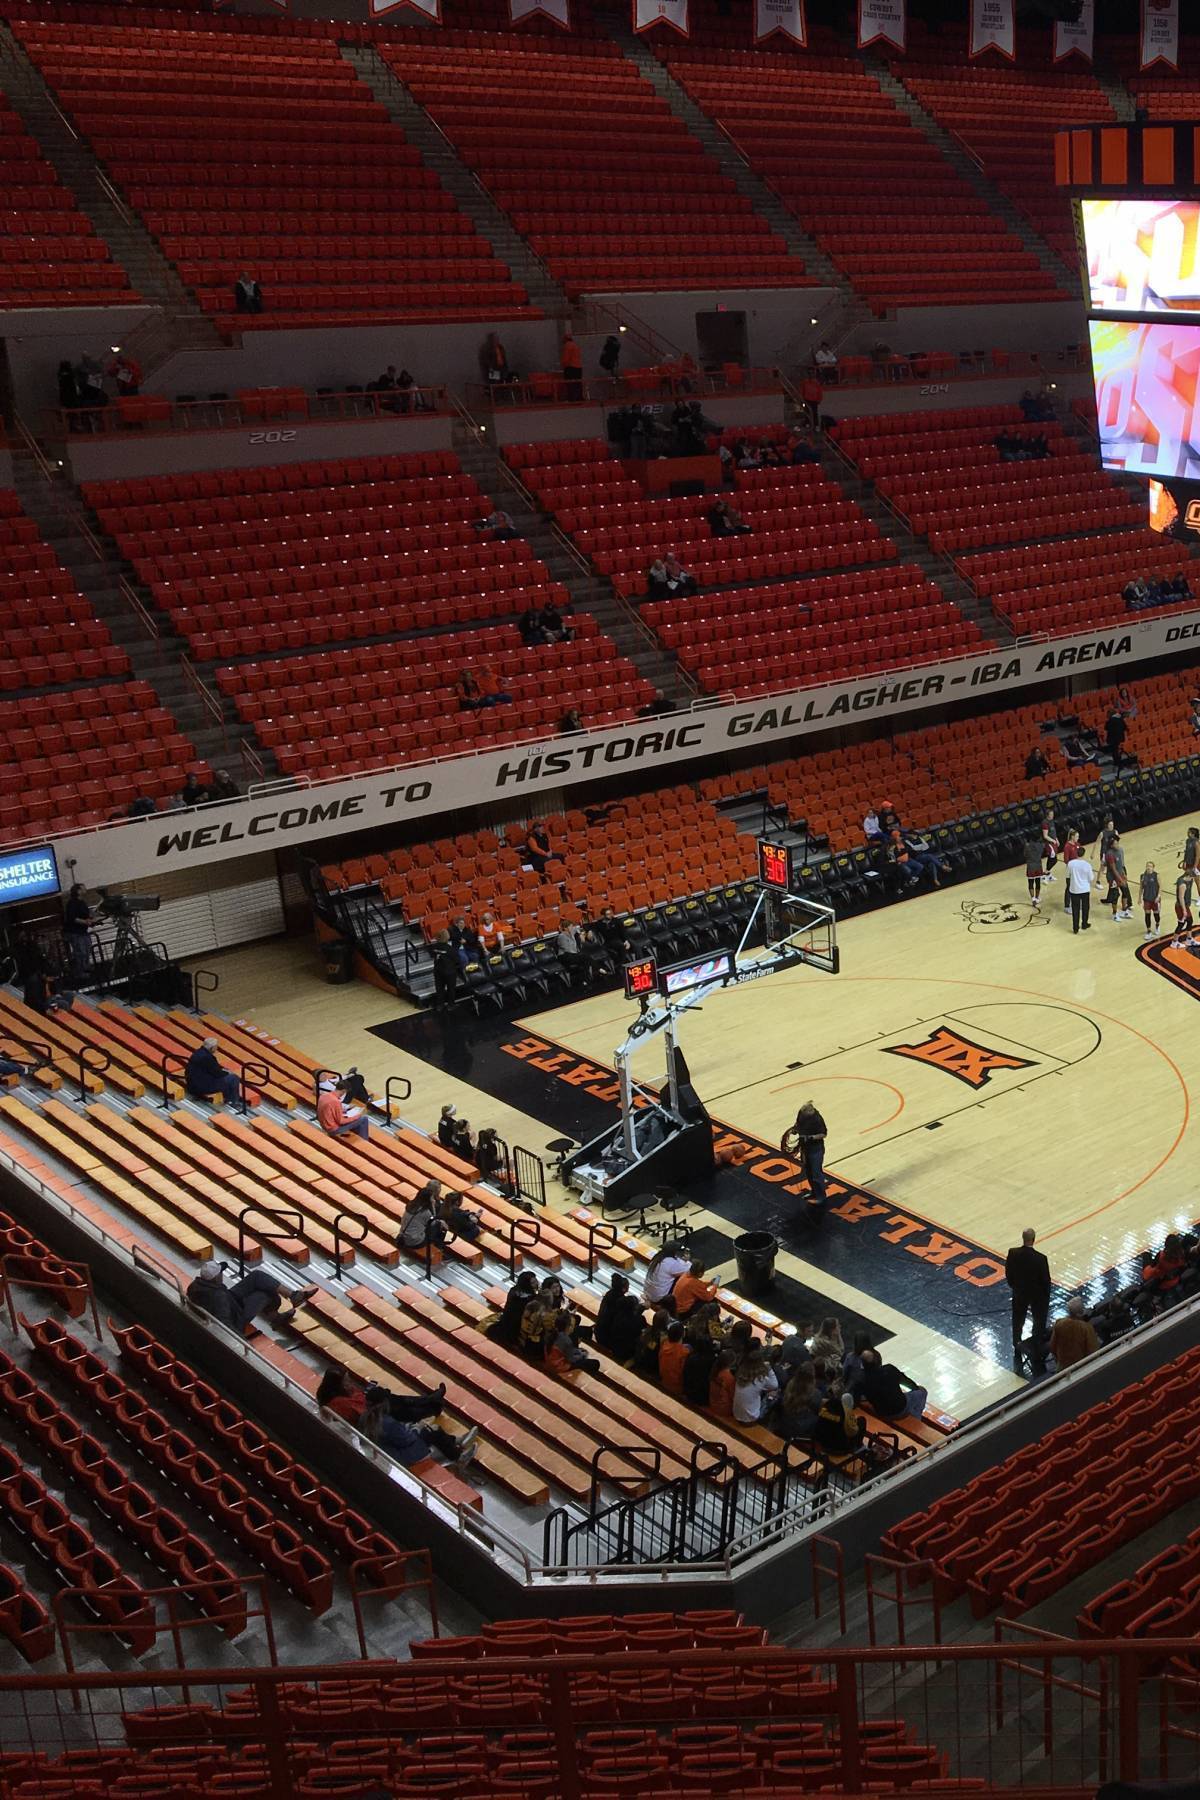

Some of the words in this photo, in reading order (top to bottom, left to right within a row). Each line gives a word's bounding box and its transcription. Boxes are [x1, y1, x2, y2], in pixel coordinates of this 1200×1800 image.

[919, 383, 950, 396] 204
[249, 429, 297, 445] 202
[496, 724, 706, 787] HISTORIC
[1034, 636, 1132, 673] ARENA
[157, 794, 367, 857] WELCOME
[380, 781, 432, 808] TO
[766, 857, 785, 886] 30
